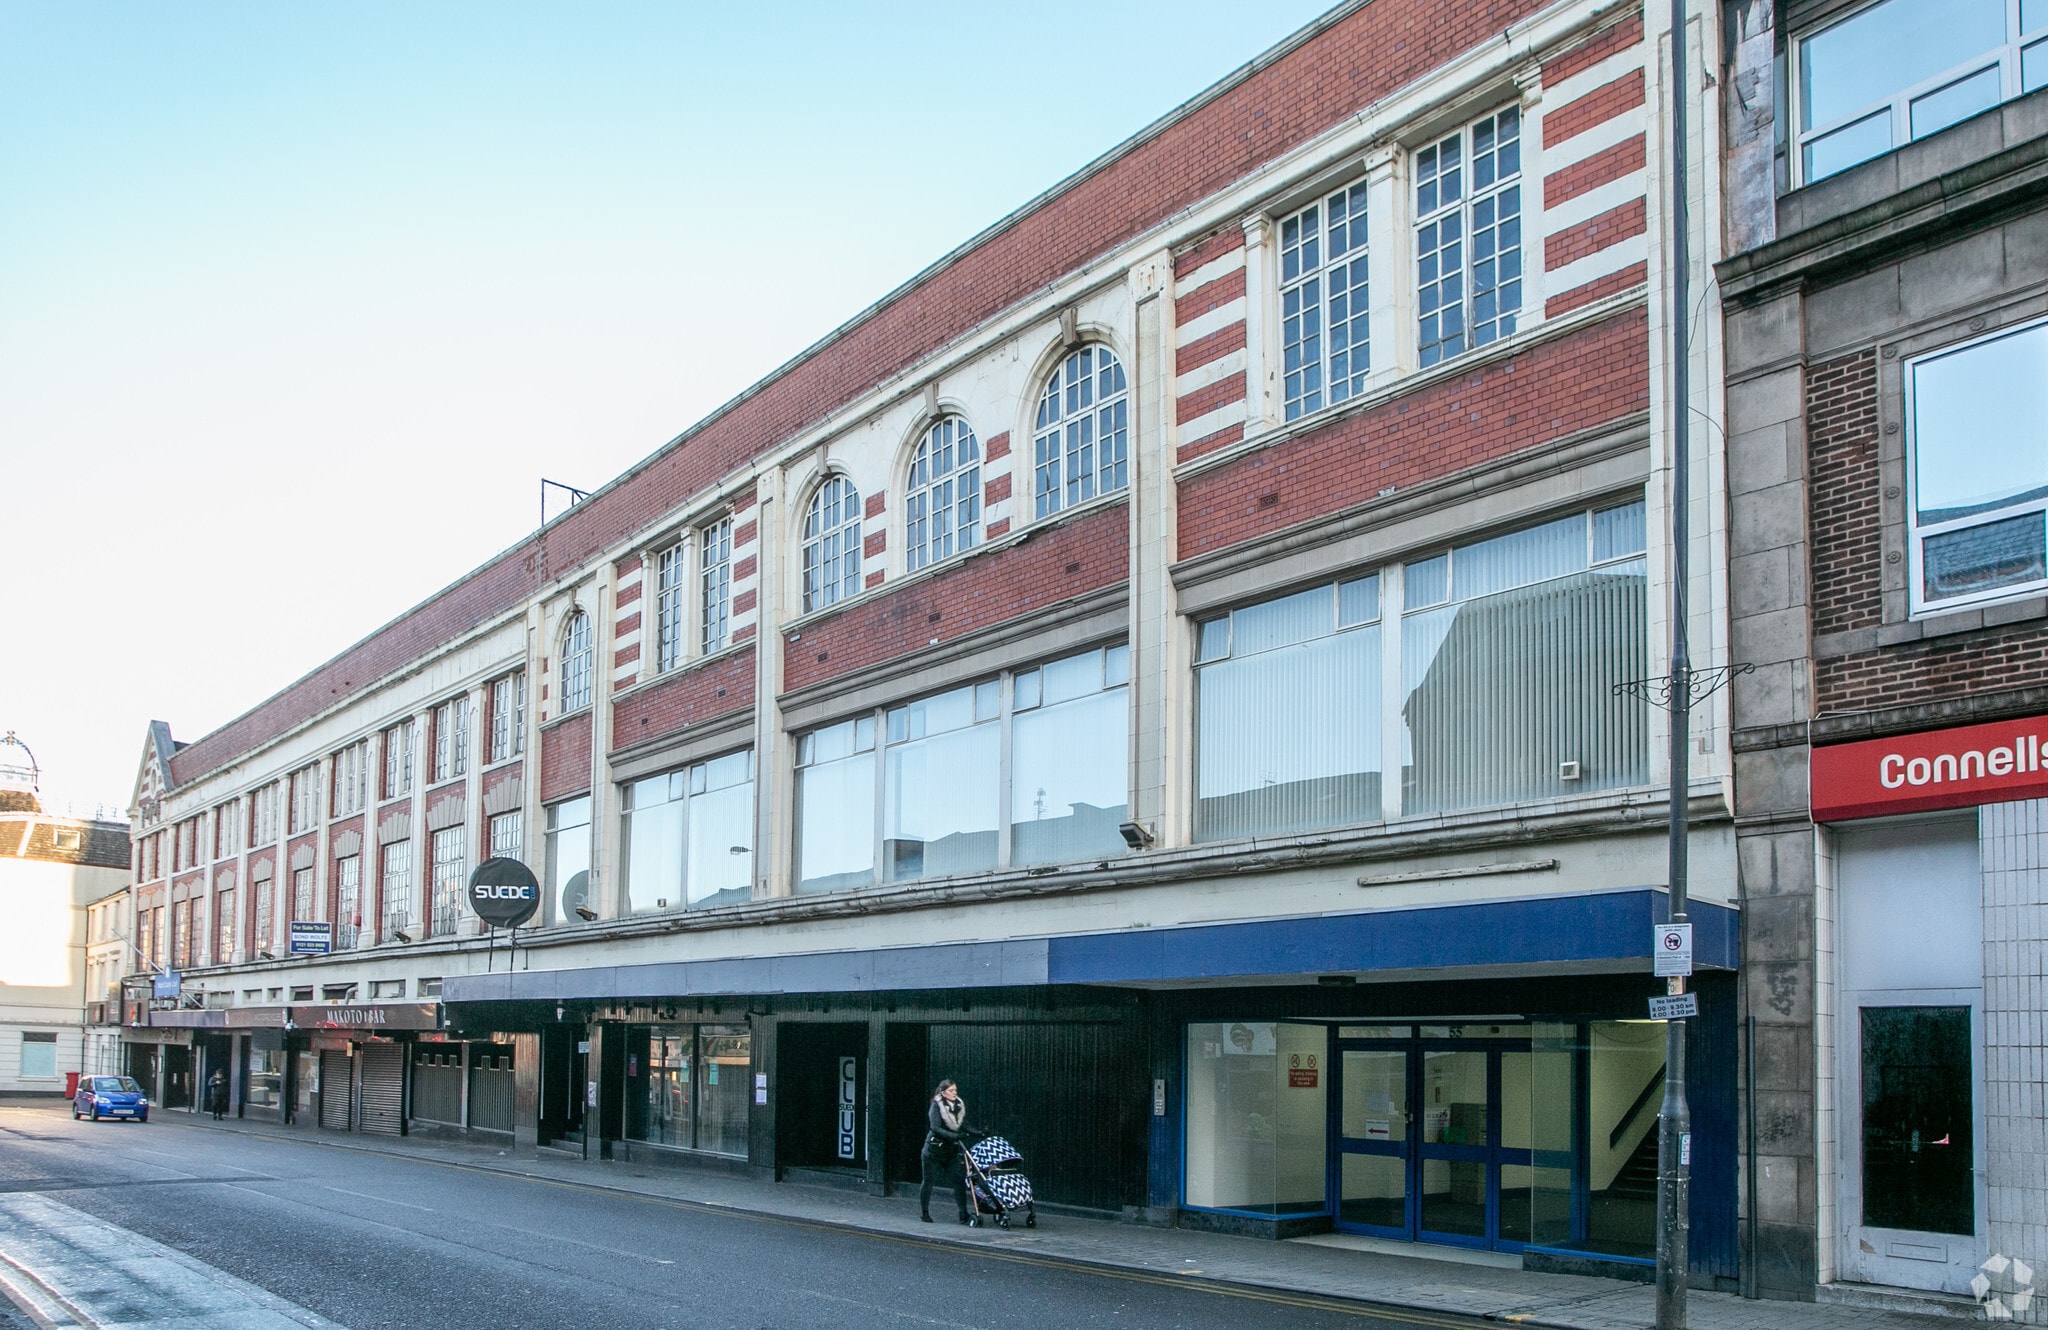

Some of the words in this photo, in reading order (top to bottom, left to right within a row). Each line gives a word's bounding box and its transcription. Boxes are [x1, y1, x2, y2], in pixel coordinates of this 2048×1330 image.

[474, 885, 530, 899] SUEDE
[327, 1010, 363, 1024] MAKOTO
[368, 1009, 386, 1024] BAR
[1449, 1025, 1463, 1038] 55
[841, 1060, 854, 1156] CLUB
